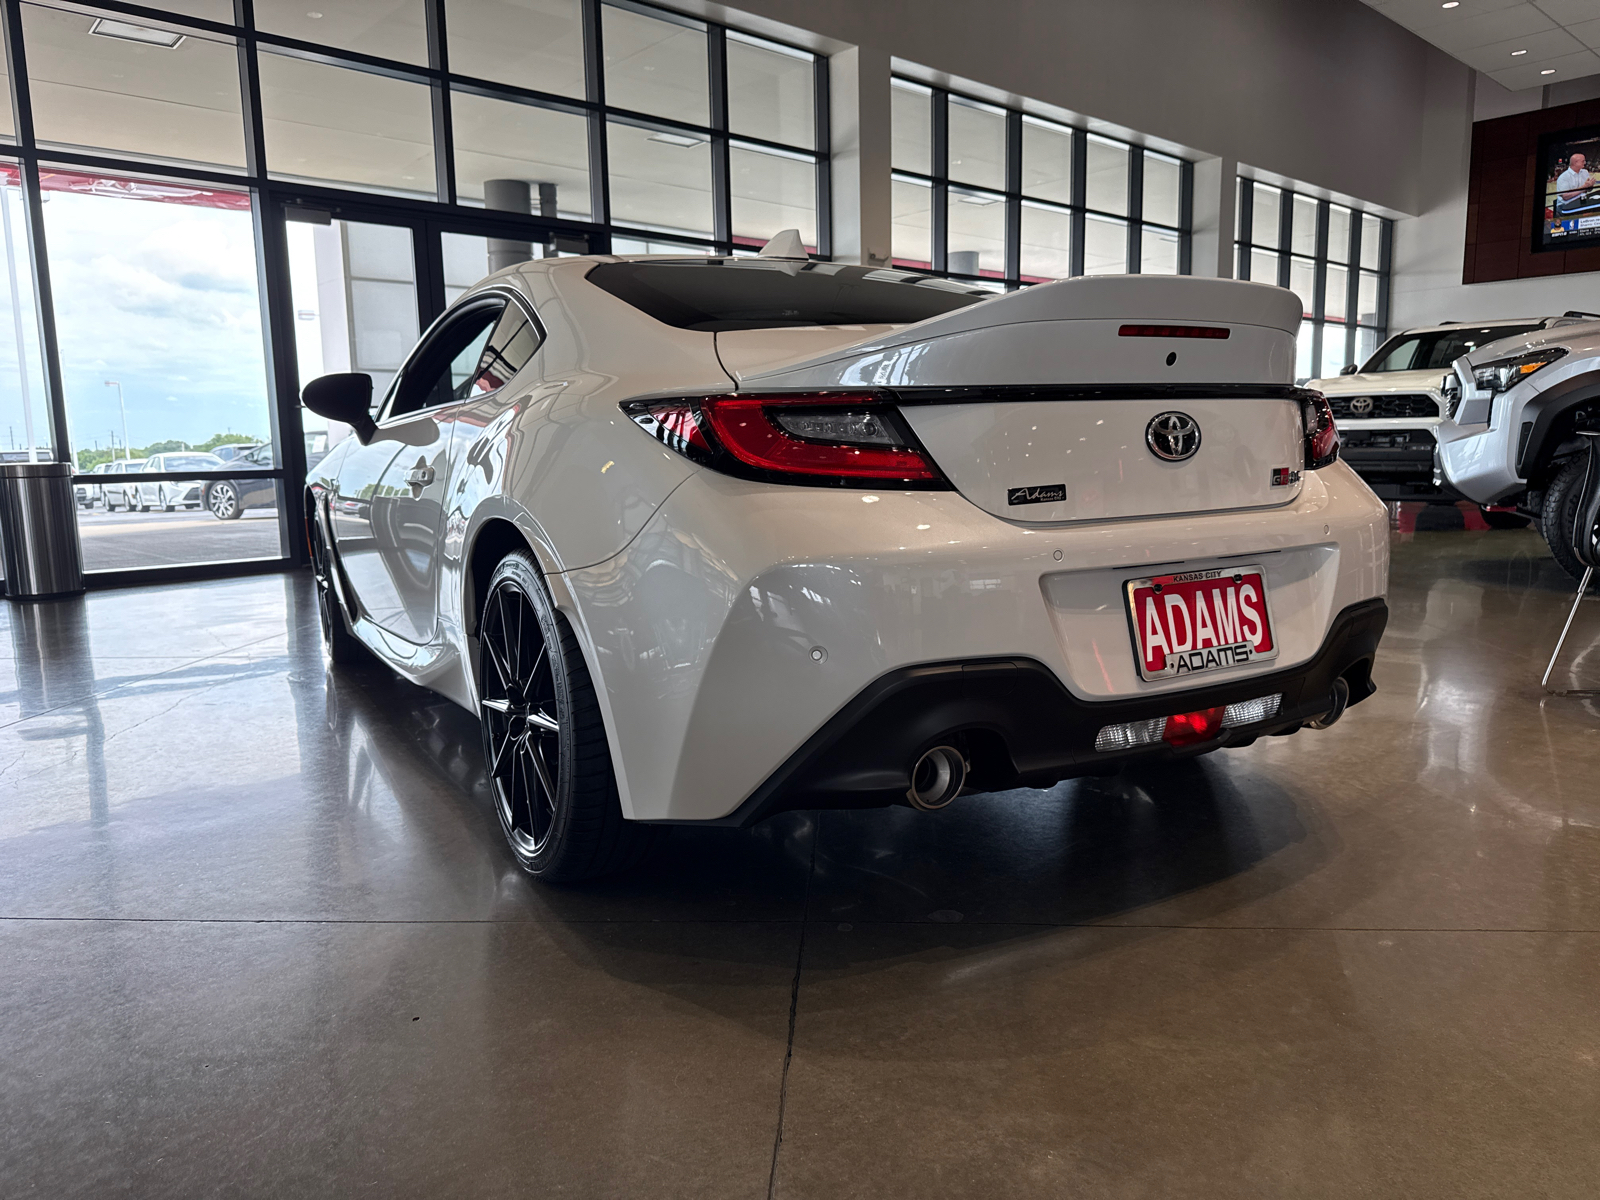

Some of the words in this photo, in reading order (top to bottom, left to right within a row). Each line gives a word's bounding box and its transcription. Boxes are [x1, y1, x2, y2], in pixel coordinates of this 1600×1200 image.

[1011, 487, 1064, 500] Adams
[1173, 573, 1204, 583] KANSAS
[1205, 570, 1222, 579] CITY
[1145, 583, 1263, 663] ADAMS
[1176, 644, 1250, 674] ADAMS
